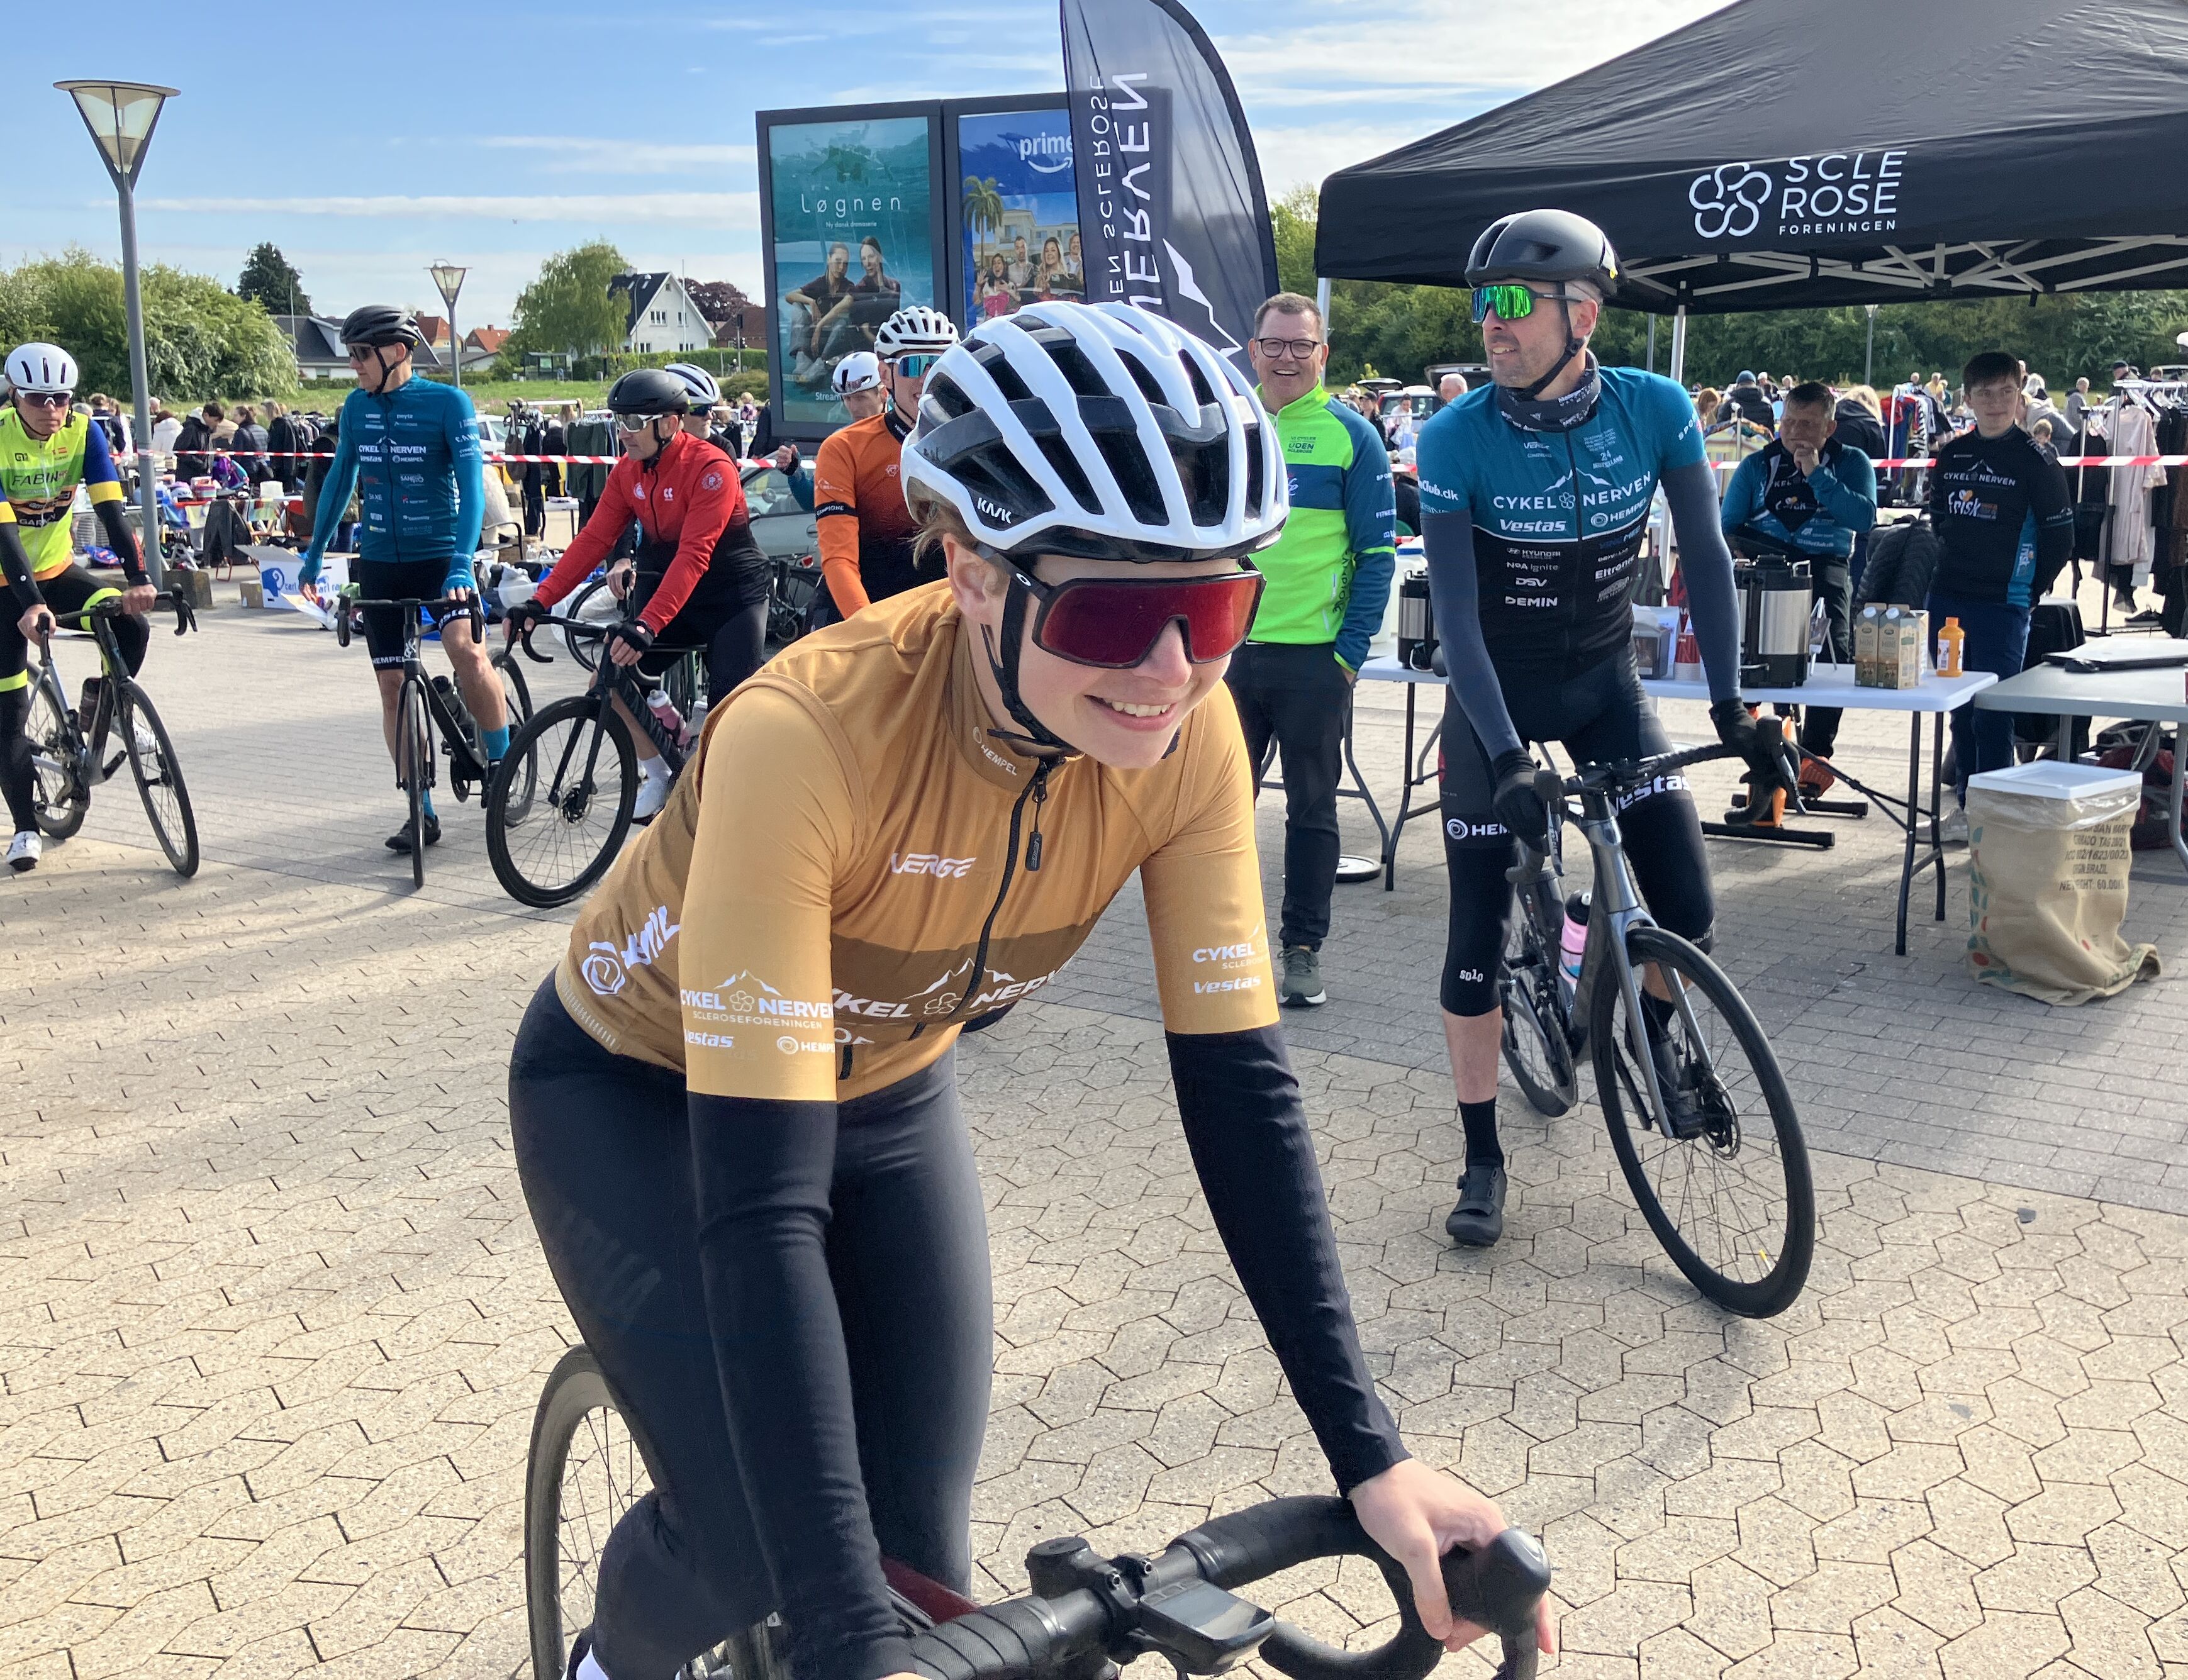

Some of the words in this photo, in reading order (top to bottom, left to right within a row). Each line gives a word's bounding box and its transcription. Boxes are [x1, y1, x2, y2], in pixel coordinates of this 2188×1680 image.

[1020, 131, 1073, 161] prime
[1785, 151, 1907, 182] SCLE
[801, 193, 901, 218] Løgnen
[1781, 182, 1900, 219] ROSE
[1779, 220, 1896, 235] FORENINGEN
[1943, 472, 1969, 481] CYKEL
[1979, 474, 2016, 486] NERVEN
[1493, 496, 1557, 510] CYKEL
[1583, 470, 1651, 507] NERVEN
[1500, 518, 1566, 533] Vestas
[1515, 577, 1548, 587] DSV
[1505, 596, 1558, 608] DEMIN
[981, 744, 1018, 776] HEMPEL
[1192, 942, 1256, 963] CYKEL
[1193, 975, 1262, 994] Vestas
[679, 988, 727, 1010] CYKEL
[758, 997, 834, 1019] NERVEN
[693, 1010, 823, 1030] SCLEROSEFORENINGEN
